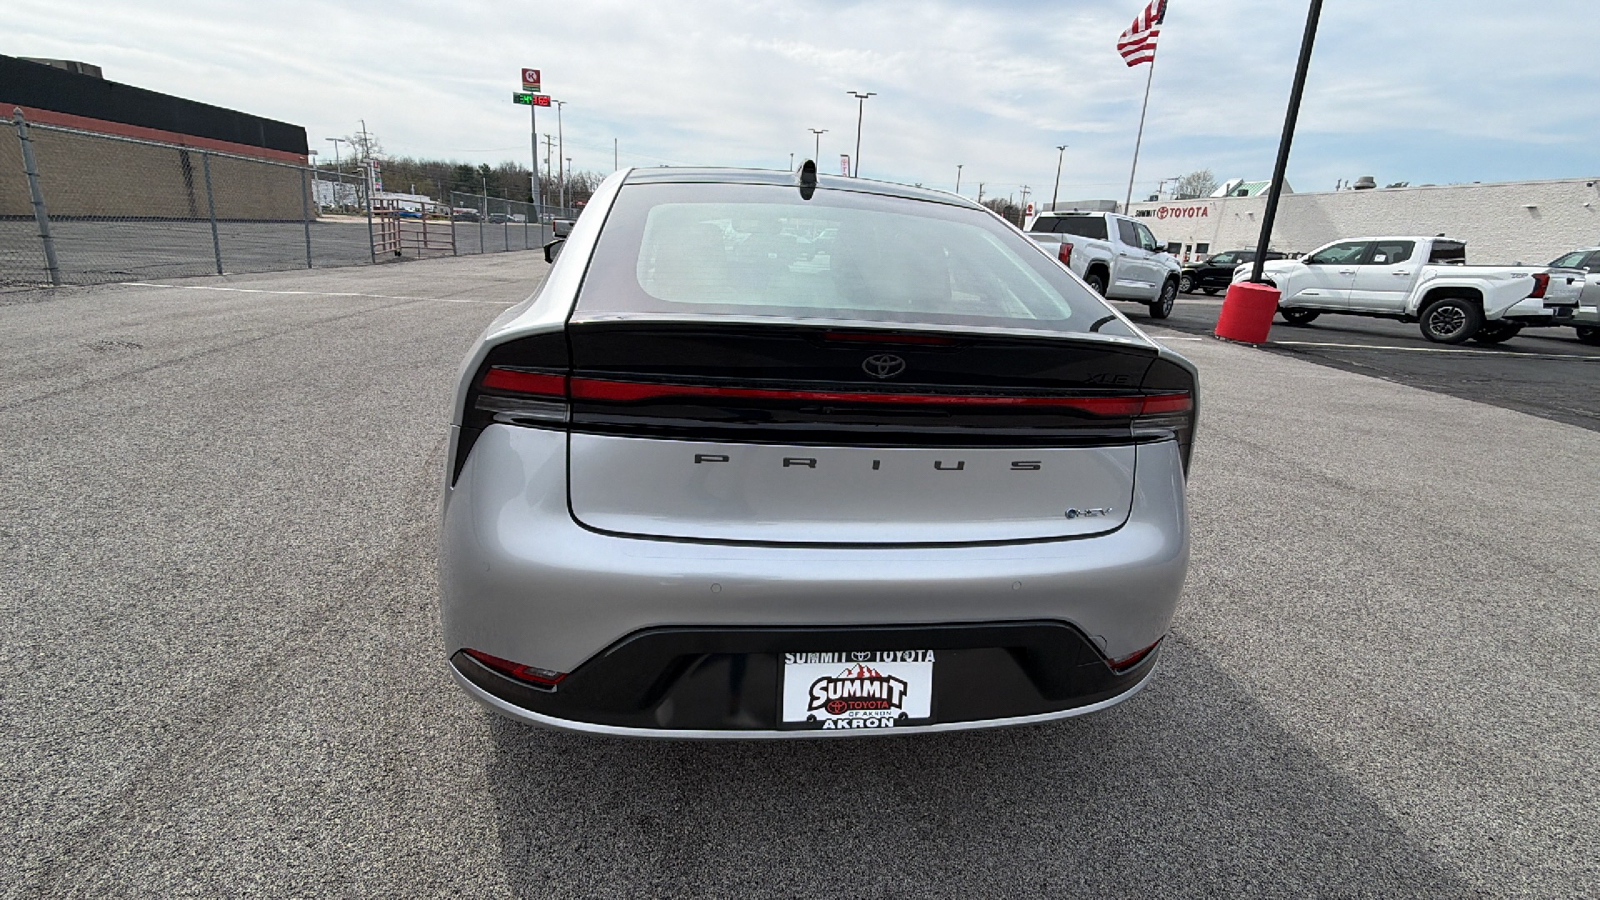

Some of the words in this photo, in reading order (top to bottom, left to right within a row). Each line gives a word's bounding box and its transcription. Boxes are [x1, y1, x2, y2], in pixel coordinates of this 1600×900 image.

[1135, 209, 1157, 218] SUMMIT
[1169, 206, 1208, 219] TOYOTA
[694, 453, 1042, 471] PRIUS
[784, 651, 847, 664] SUMMIT
[876, 649, 936, 663] TOYOTA
[809, 676, 906, 710] SUMMIT
[849, 701, 890, 709] TOYOTA
[822, 717, 894, 729] AKRON
